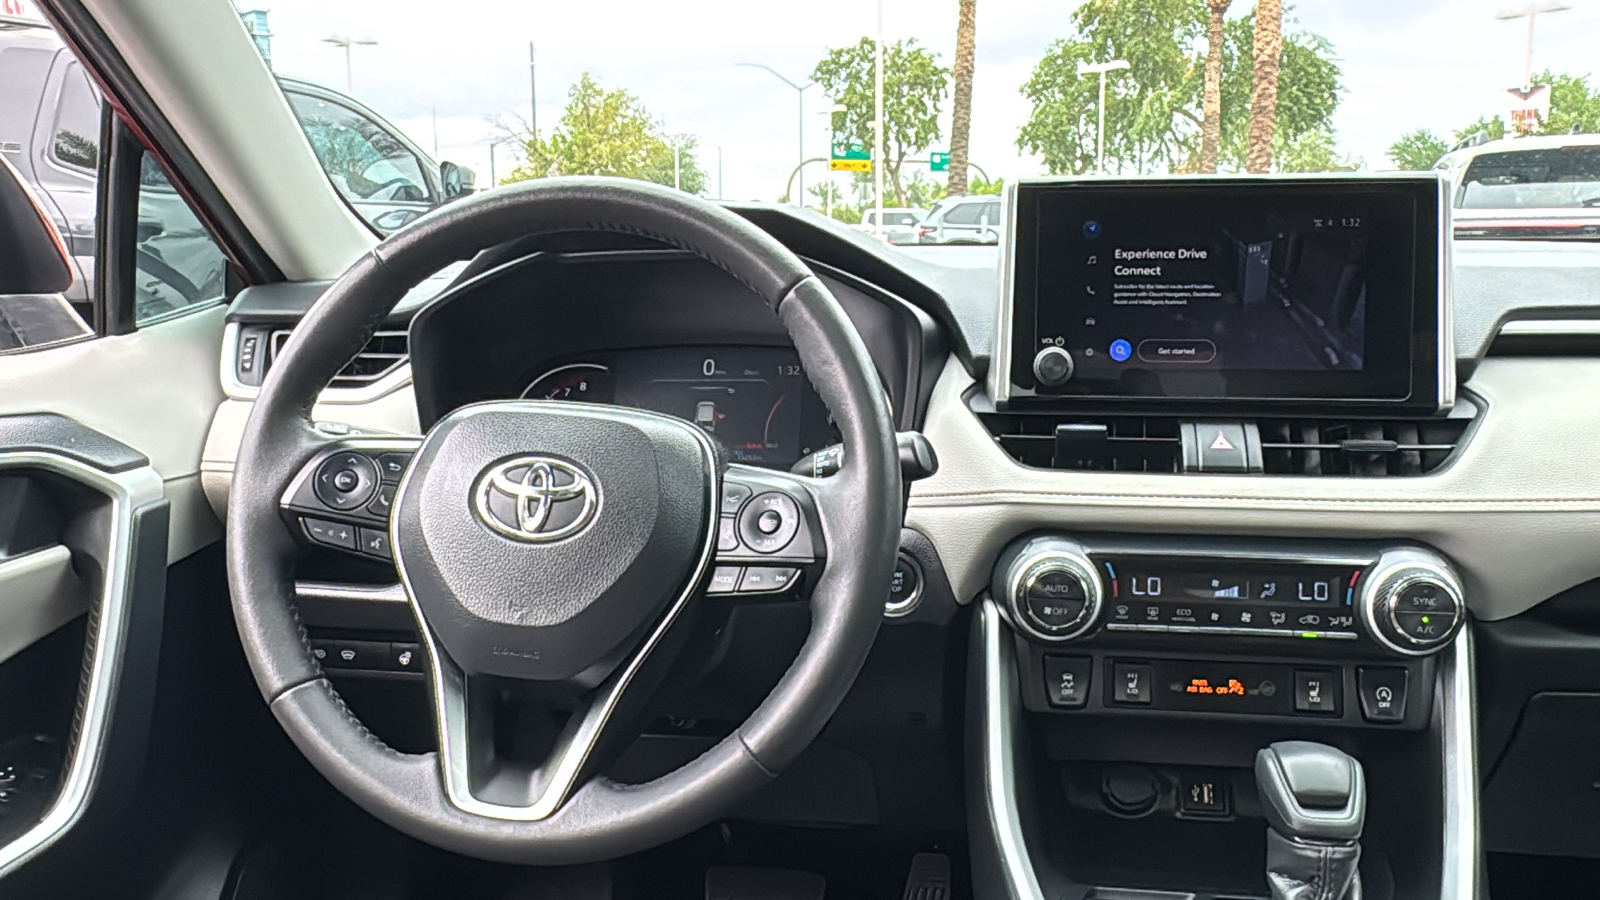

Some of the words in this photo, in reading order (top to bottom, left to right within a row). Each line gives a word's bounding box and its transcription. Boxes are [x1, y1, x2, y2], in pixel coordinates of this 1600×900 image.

[1341, 218, 1361, 227] 1:32
[1114, 249, 1176, 260] Experience
[1178, 249, 1207, 259] Drive
[1114, 265, 1161, 275] Connect
[1158, 347, 1170, 355] Get
[1171, 347, 1196, 355] started
[703, 359, 715, 376] 0
[778, 366, 800, 376] 1:32
[580, 382, 587, 391] 8
[565, 388, 571, 397] 7
[1045, 584, 1068, 593] AUTO
[1132, 577, 1161, 595] LO
[1298, 582, 1328, 601] LO
[1413, 597, 1437, 606] SYNC
[1052, 607, 1068, 616] OFF
[1176, 608, 1191, 616] ECO
[1417, 626, 1434, 634] A/C
